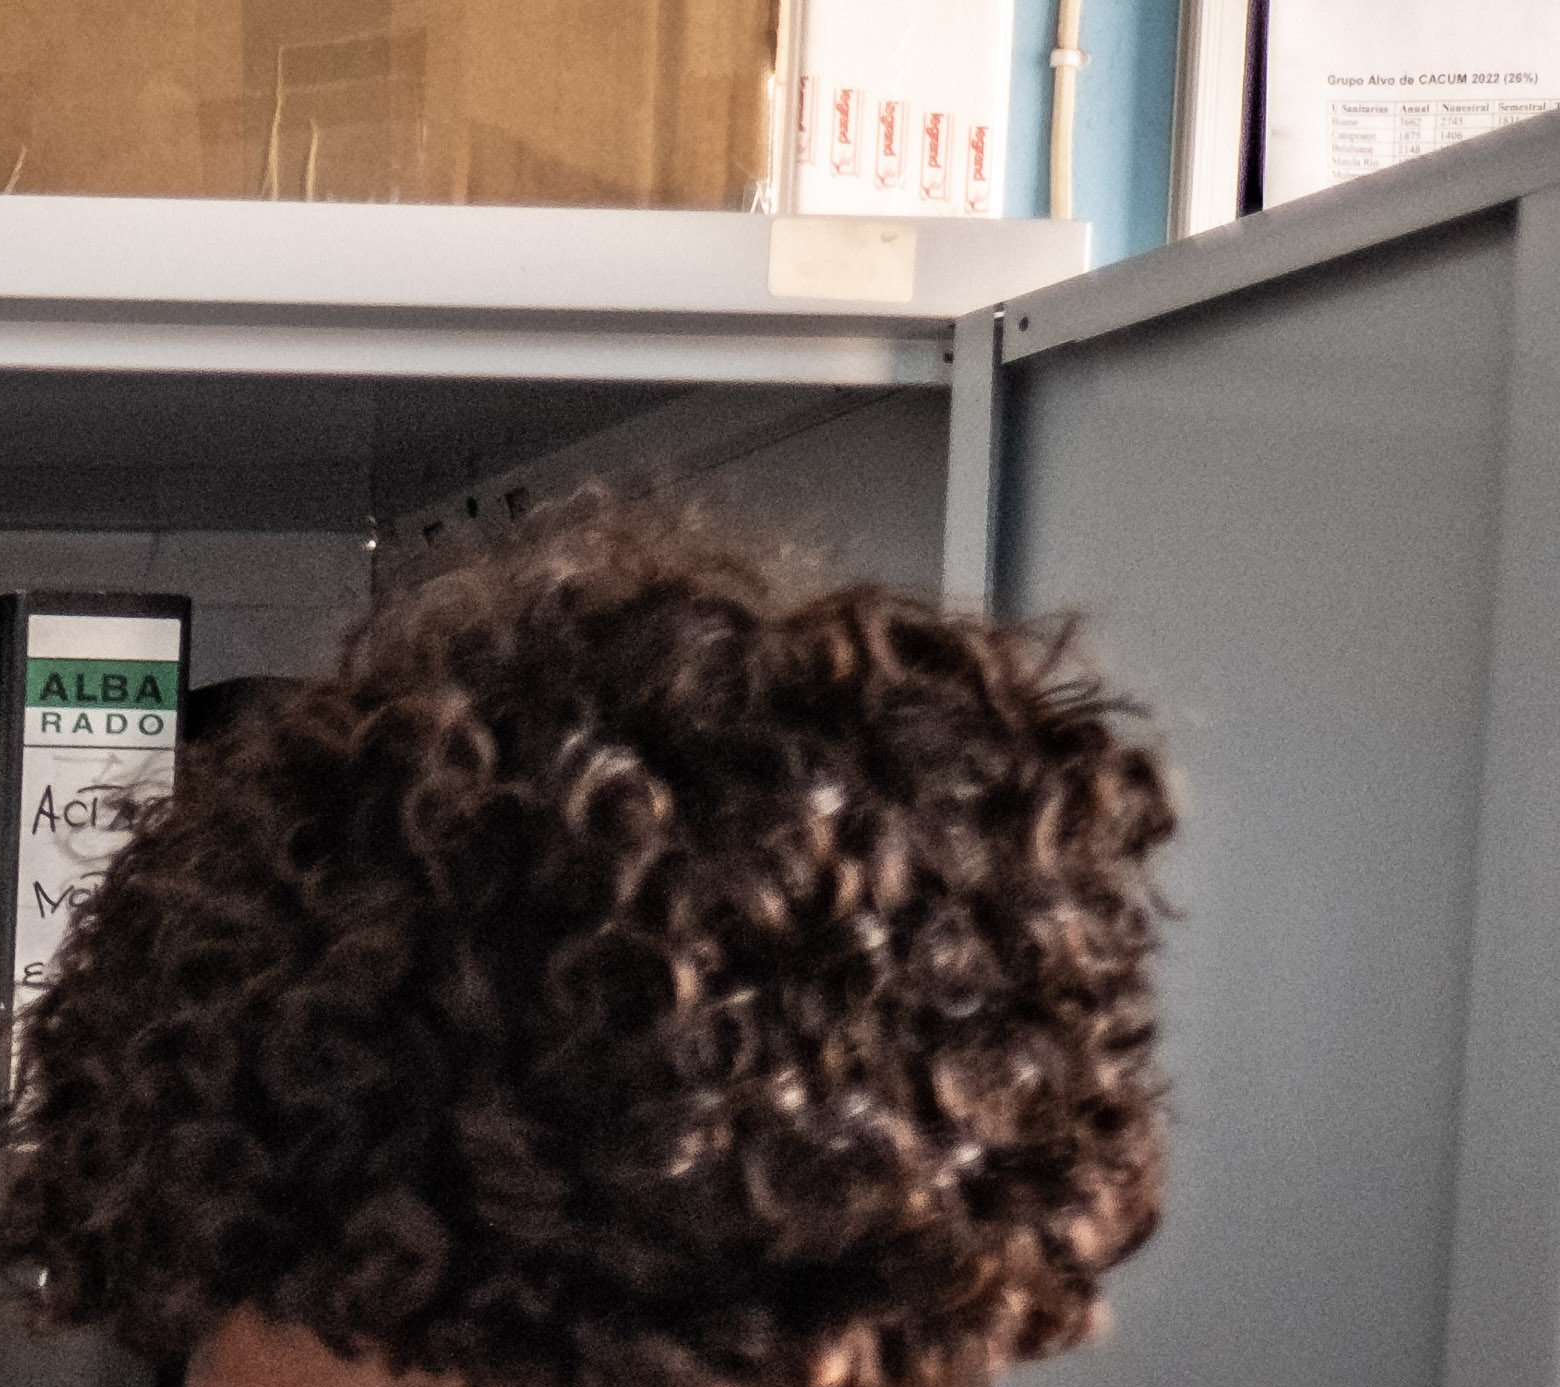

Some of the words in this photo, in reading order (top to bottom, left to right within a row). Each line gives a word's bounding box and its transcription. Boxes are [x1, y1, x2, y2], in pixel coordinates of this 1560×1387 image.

[1327, 74, 1364, 87] Grupo
[1368, 73, 1396, 86] Alvo
[1399, 74, 1414, 86] de
[1418, 72, 1468, 85] CACUM
[1471, 72, 1500, 84] 2022
[39, 672, 163, 704] ALBA
[40, 712, 164, 736] RADO
